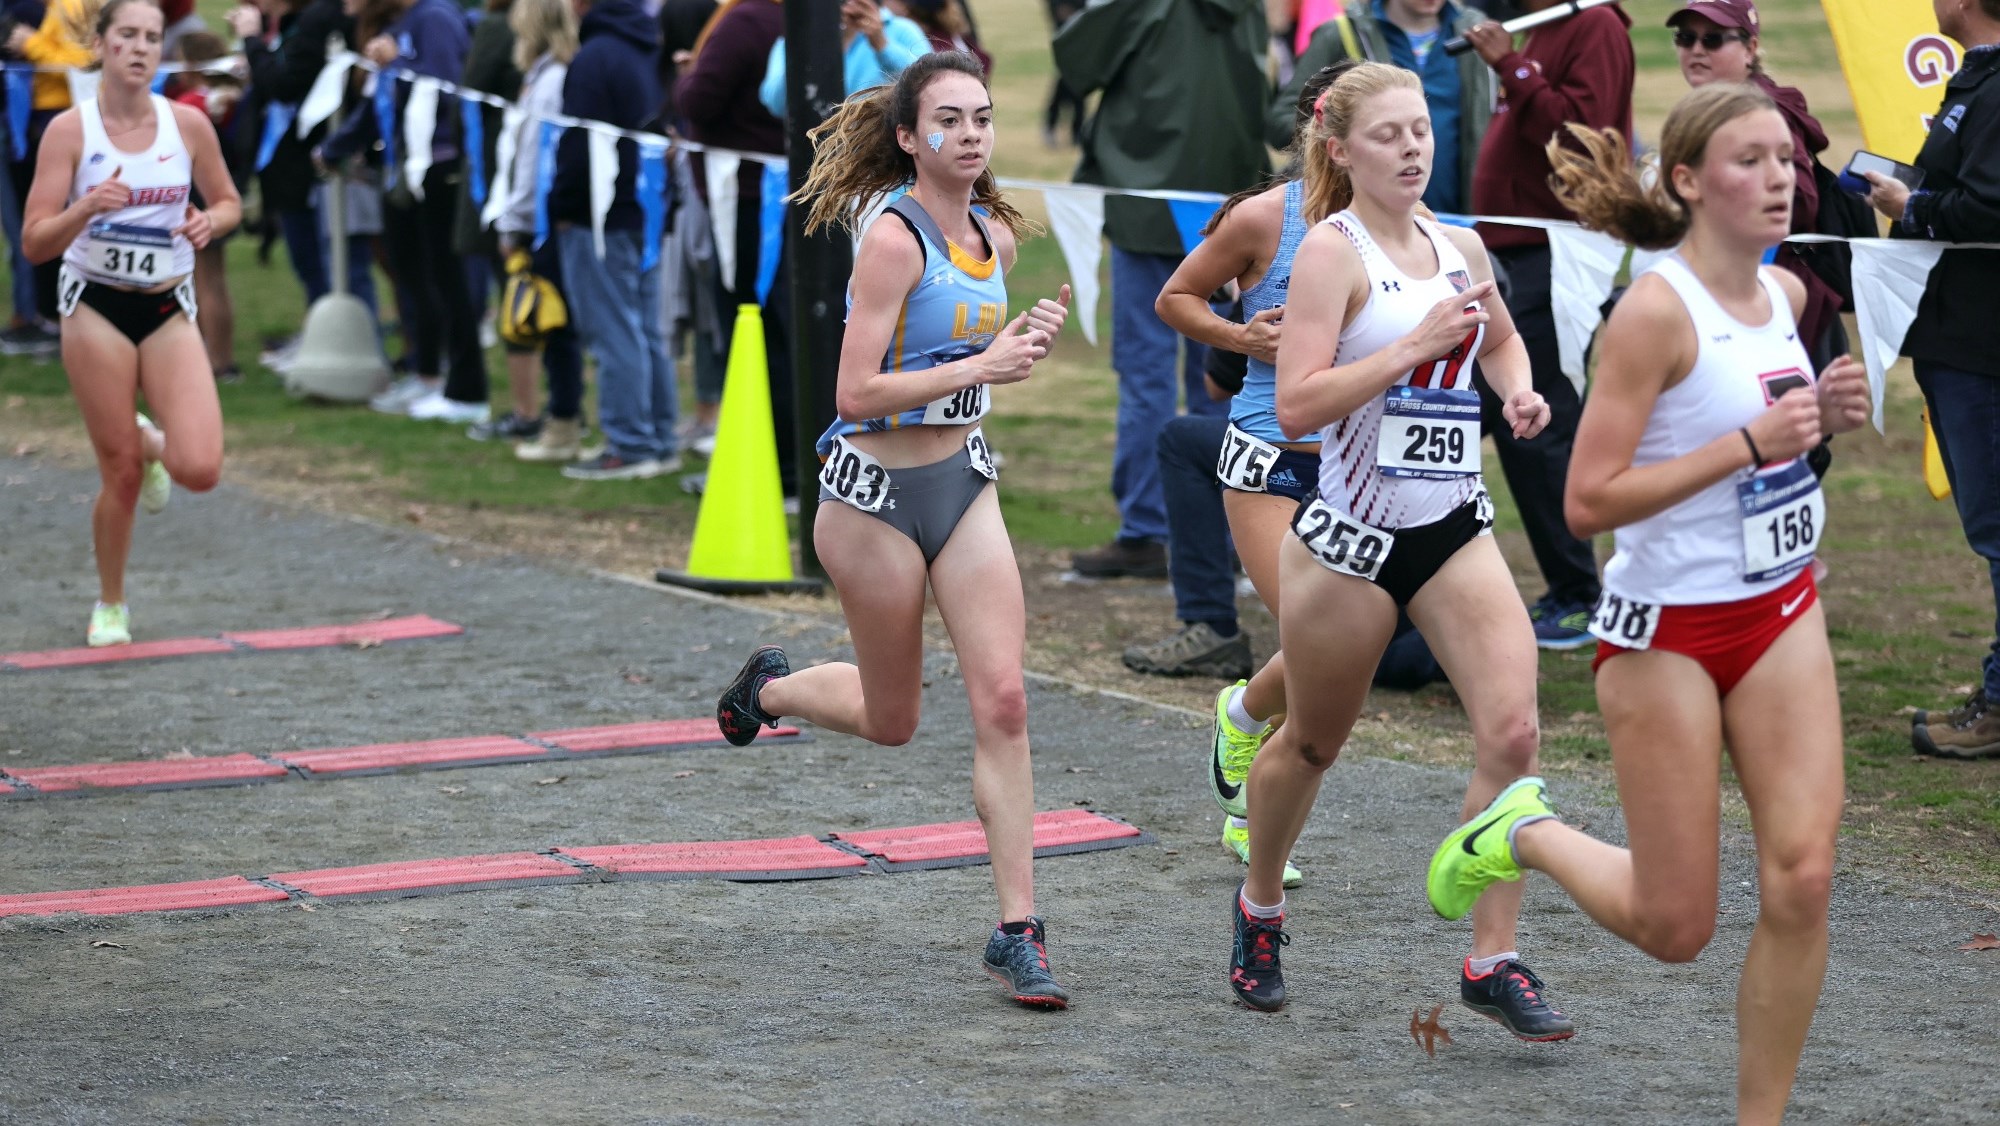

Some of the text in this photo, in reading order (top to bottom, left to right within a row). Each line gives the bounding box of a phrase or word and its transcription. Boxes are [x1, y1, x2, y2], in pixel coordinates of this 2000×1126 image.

[104, 248, 155, 275] 314
[1400, 402, 1422, 410] CROSS
[1422, 403, 1446, 412] COUNTRY
[1218, 430, 1274, 488] 375
[1402, 424, 1464, 464] 259
[824, 439, 886, 507] 303
[1301, 508, 1383, 574] 259
[1768, 504, 1814, 558] 158
